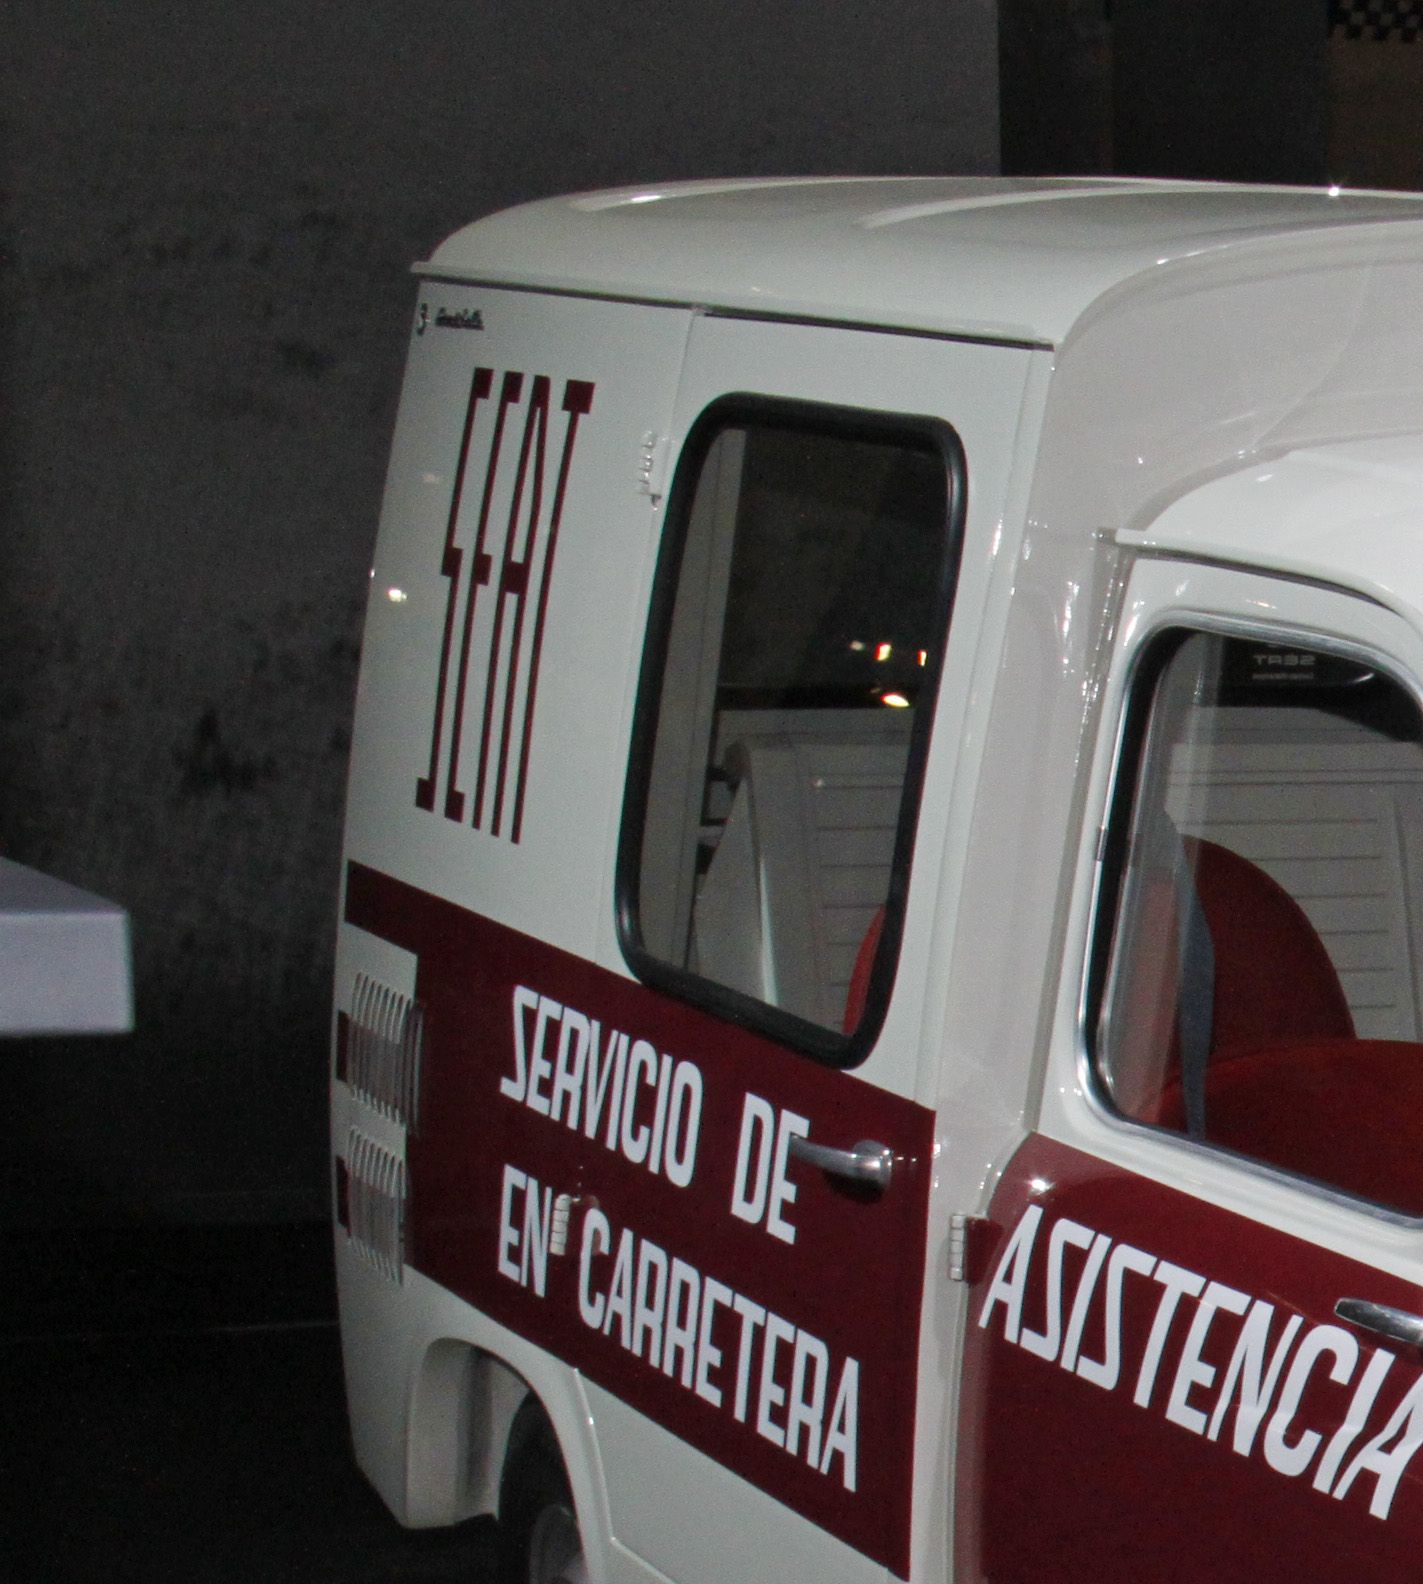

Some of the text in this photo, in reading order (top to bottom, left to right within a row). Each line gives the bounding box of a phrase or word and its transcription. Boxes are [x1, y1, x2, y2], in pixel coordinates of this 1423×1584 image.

[416, 367, 595, 844] SEAT
[500, 984, 810, 1245] SERVICIO DE
[498, 1164, 858, 1492] EN CARRETERA
